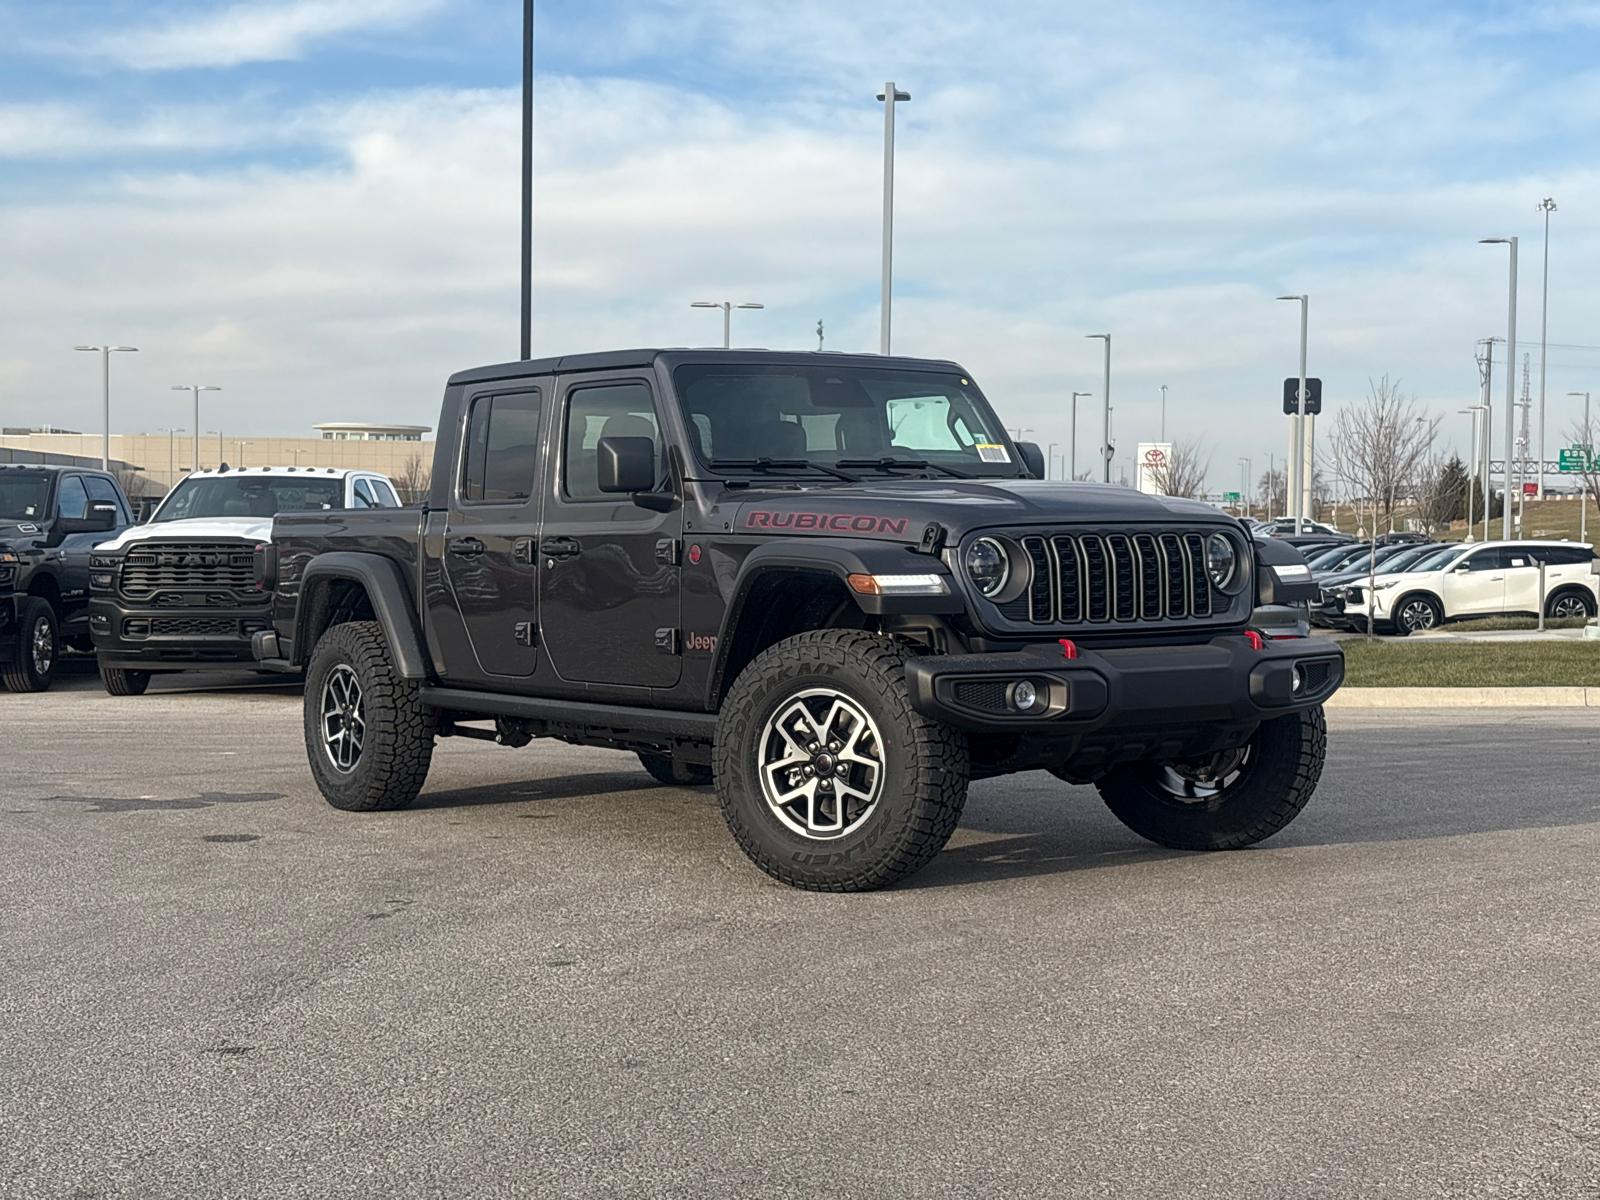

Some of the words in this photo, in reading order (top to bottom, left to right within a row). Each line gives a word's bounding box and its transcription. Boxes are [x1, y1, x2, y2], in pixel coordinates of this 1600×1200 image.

[746, 511, 909, 535] RUBICON
[157, 554, 229, 566] RAM
[685, 631, 718, 653] Jeep
[730, 665, 793, 793] WILDPEAK
[797, 662, 840, 677] A/T
